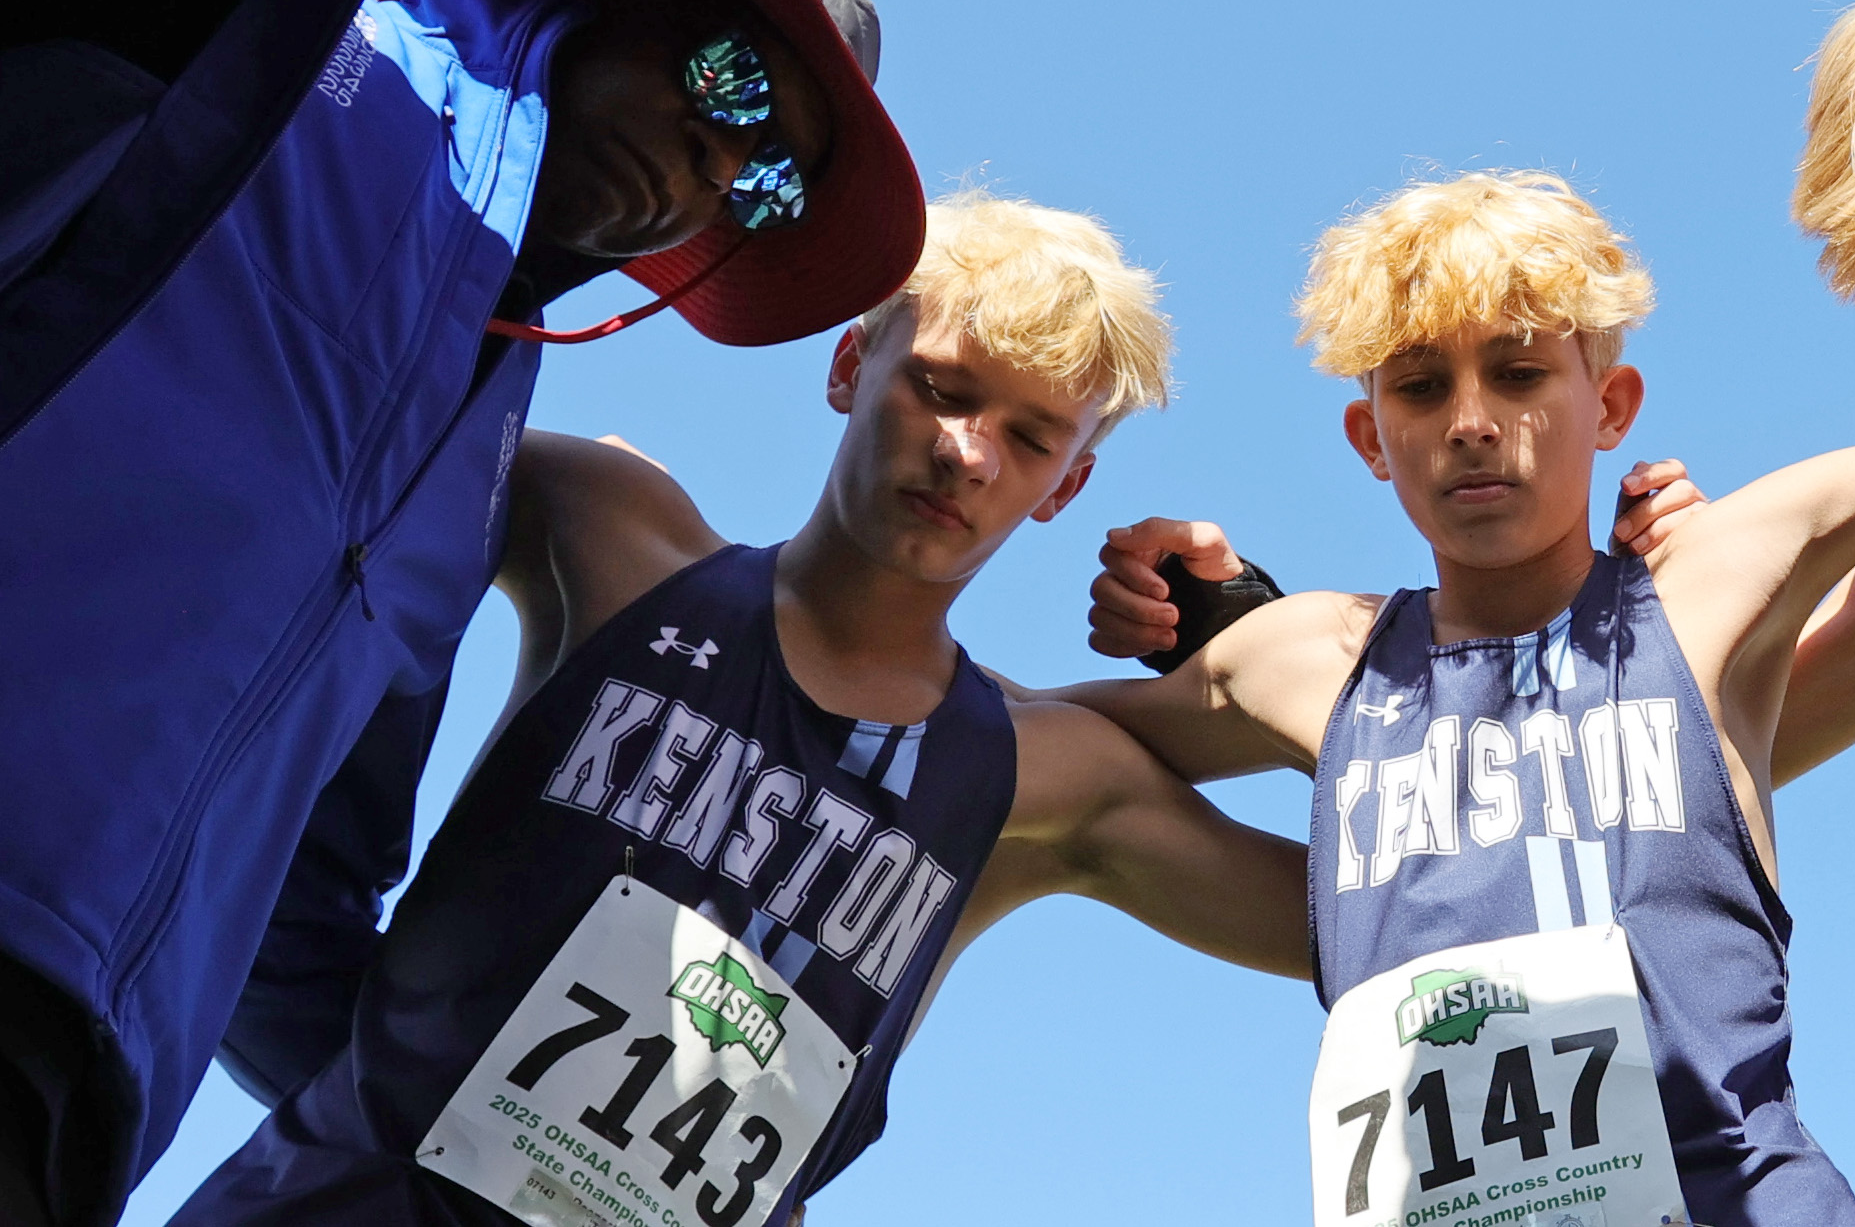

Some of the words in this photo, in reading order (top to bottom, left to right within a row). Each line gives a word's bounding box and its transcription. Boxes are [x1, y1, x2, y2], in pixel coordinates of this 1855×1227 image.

[541, 677, 957, 1000] KENSTON
[1335, 696, 1687, 895] KENSTON
[678, 966, 780, 1060] OHSAA
[1400, 977, 1521, 1039] OHSAA
[489, 1094, 543, 1130] 2025
[544, 1124, 612, 1178] OHSAA
[615, 1171, 660, 1214] Cross
[505, 981, 783, 1227] 7143
[512, 1133, 566, 1176] State
[1337, 1026, 1620, 1219] 7147
[1405, 1191, 1482, 1227] OHSAA
[1486, 1174, 1549, 1201] Cross
[1555, 1152, 1644, 1183] Country
